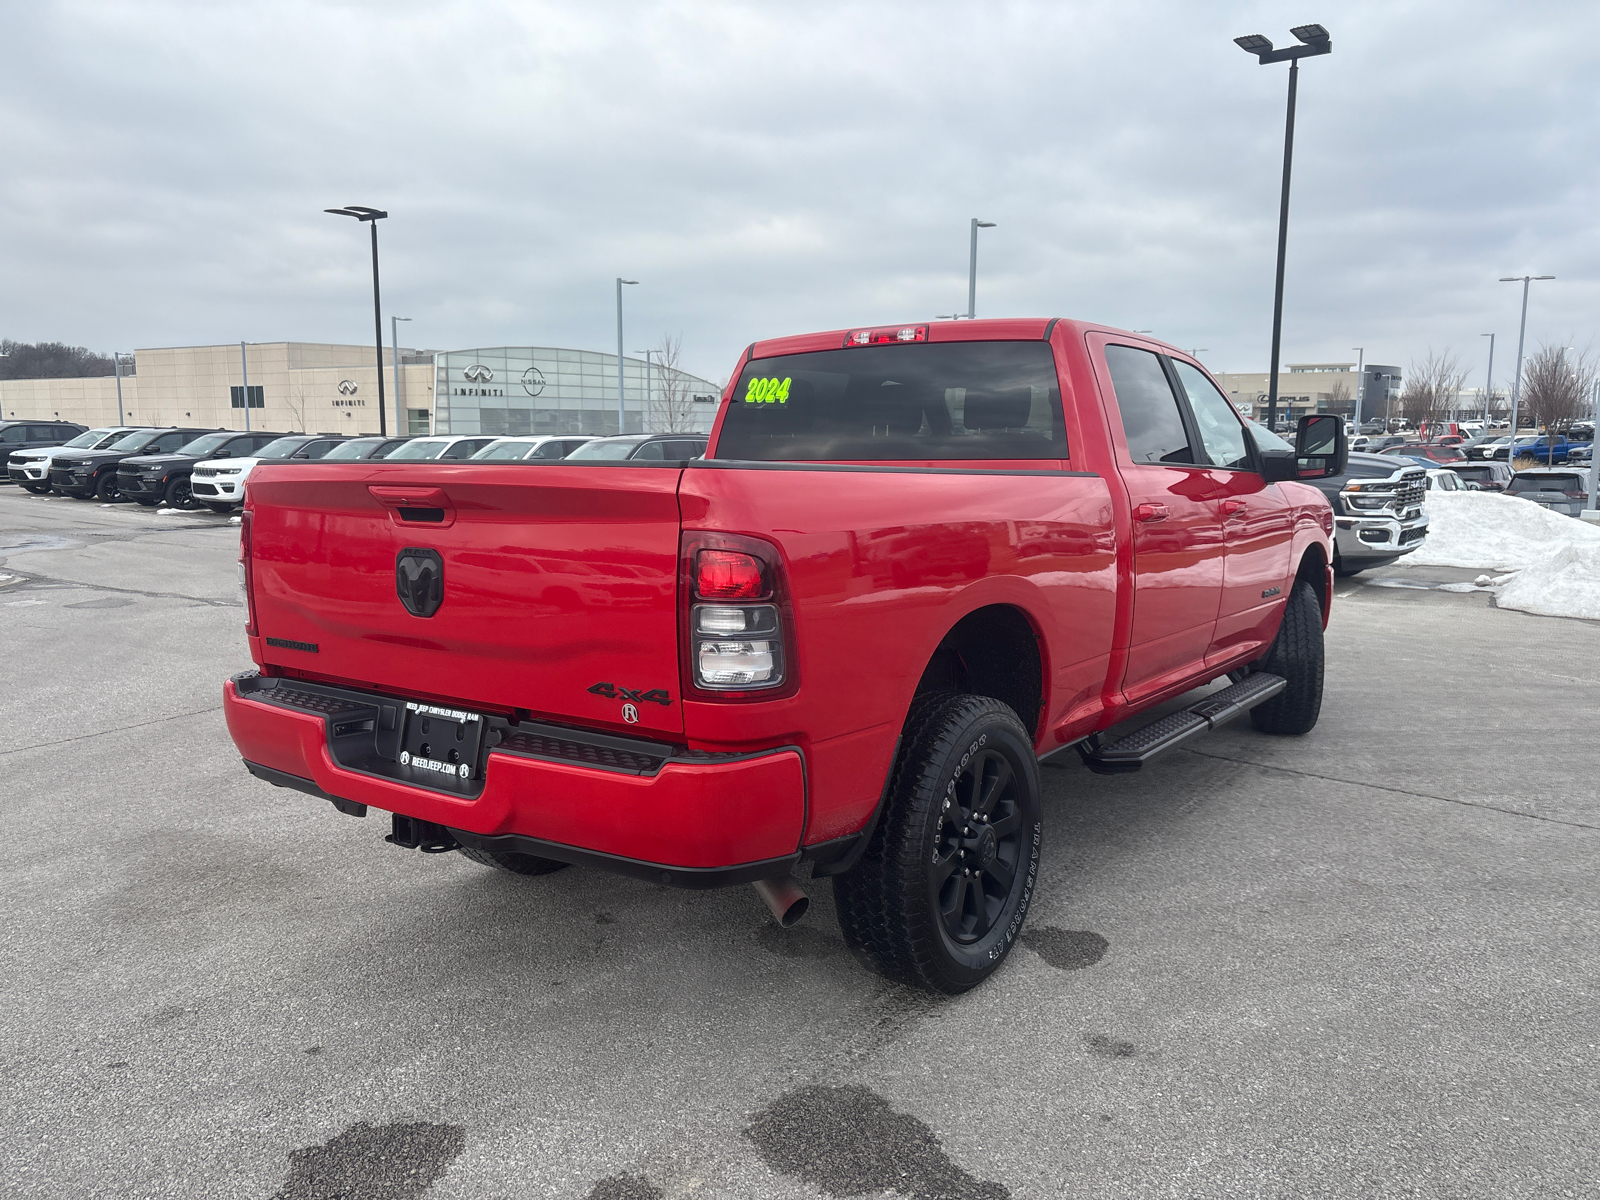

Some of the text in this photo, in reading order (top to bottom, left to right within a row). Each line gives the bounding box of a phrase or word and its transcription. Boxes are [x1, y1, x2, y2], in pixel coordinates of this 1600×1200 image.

[454, 388, 503, 397] INFINITI
[745, 377, 792, 403] 2024
[332, 399, 365, 407] INFINITI
[428, 706, 452, 717] CHRYSLER
[451, 710, 467, 720] DODGE
[467, 712, 479, 722] RAM
[411, 756, 456, 775] REEDJEEP.COM
[1004, 822, 1041, 943] TRANSFORCE
